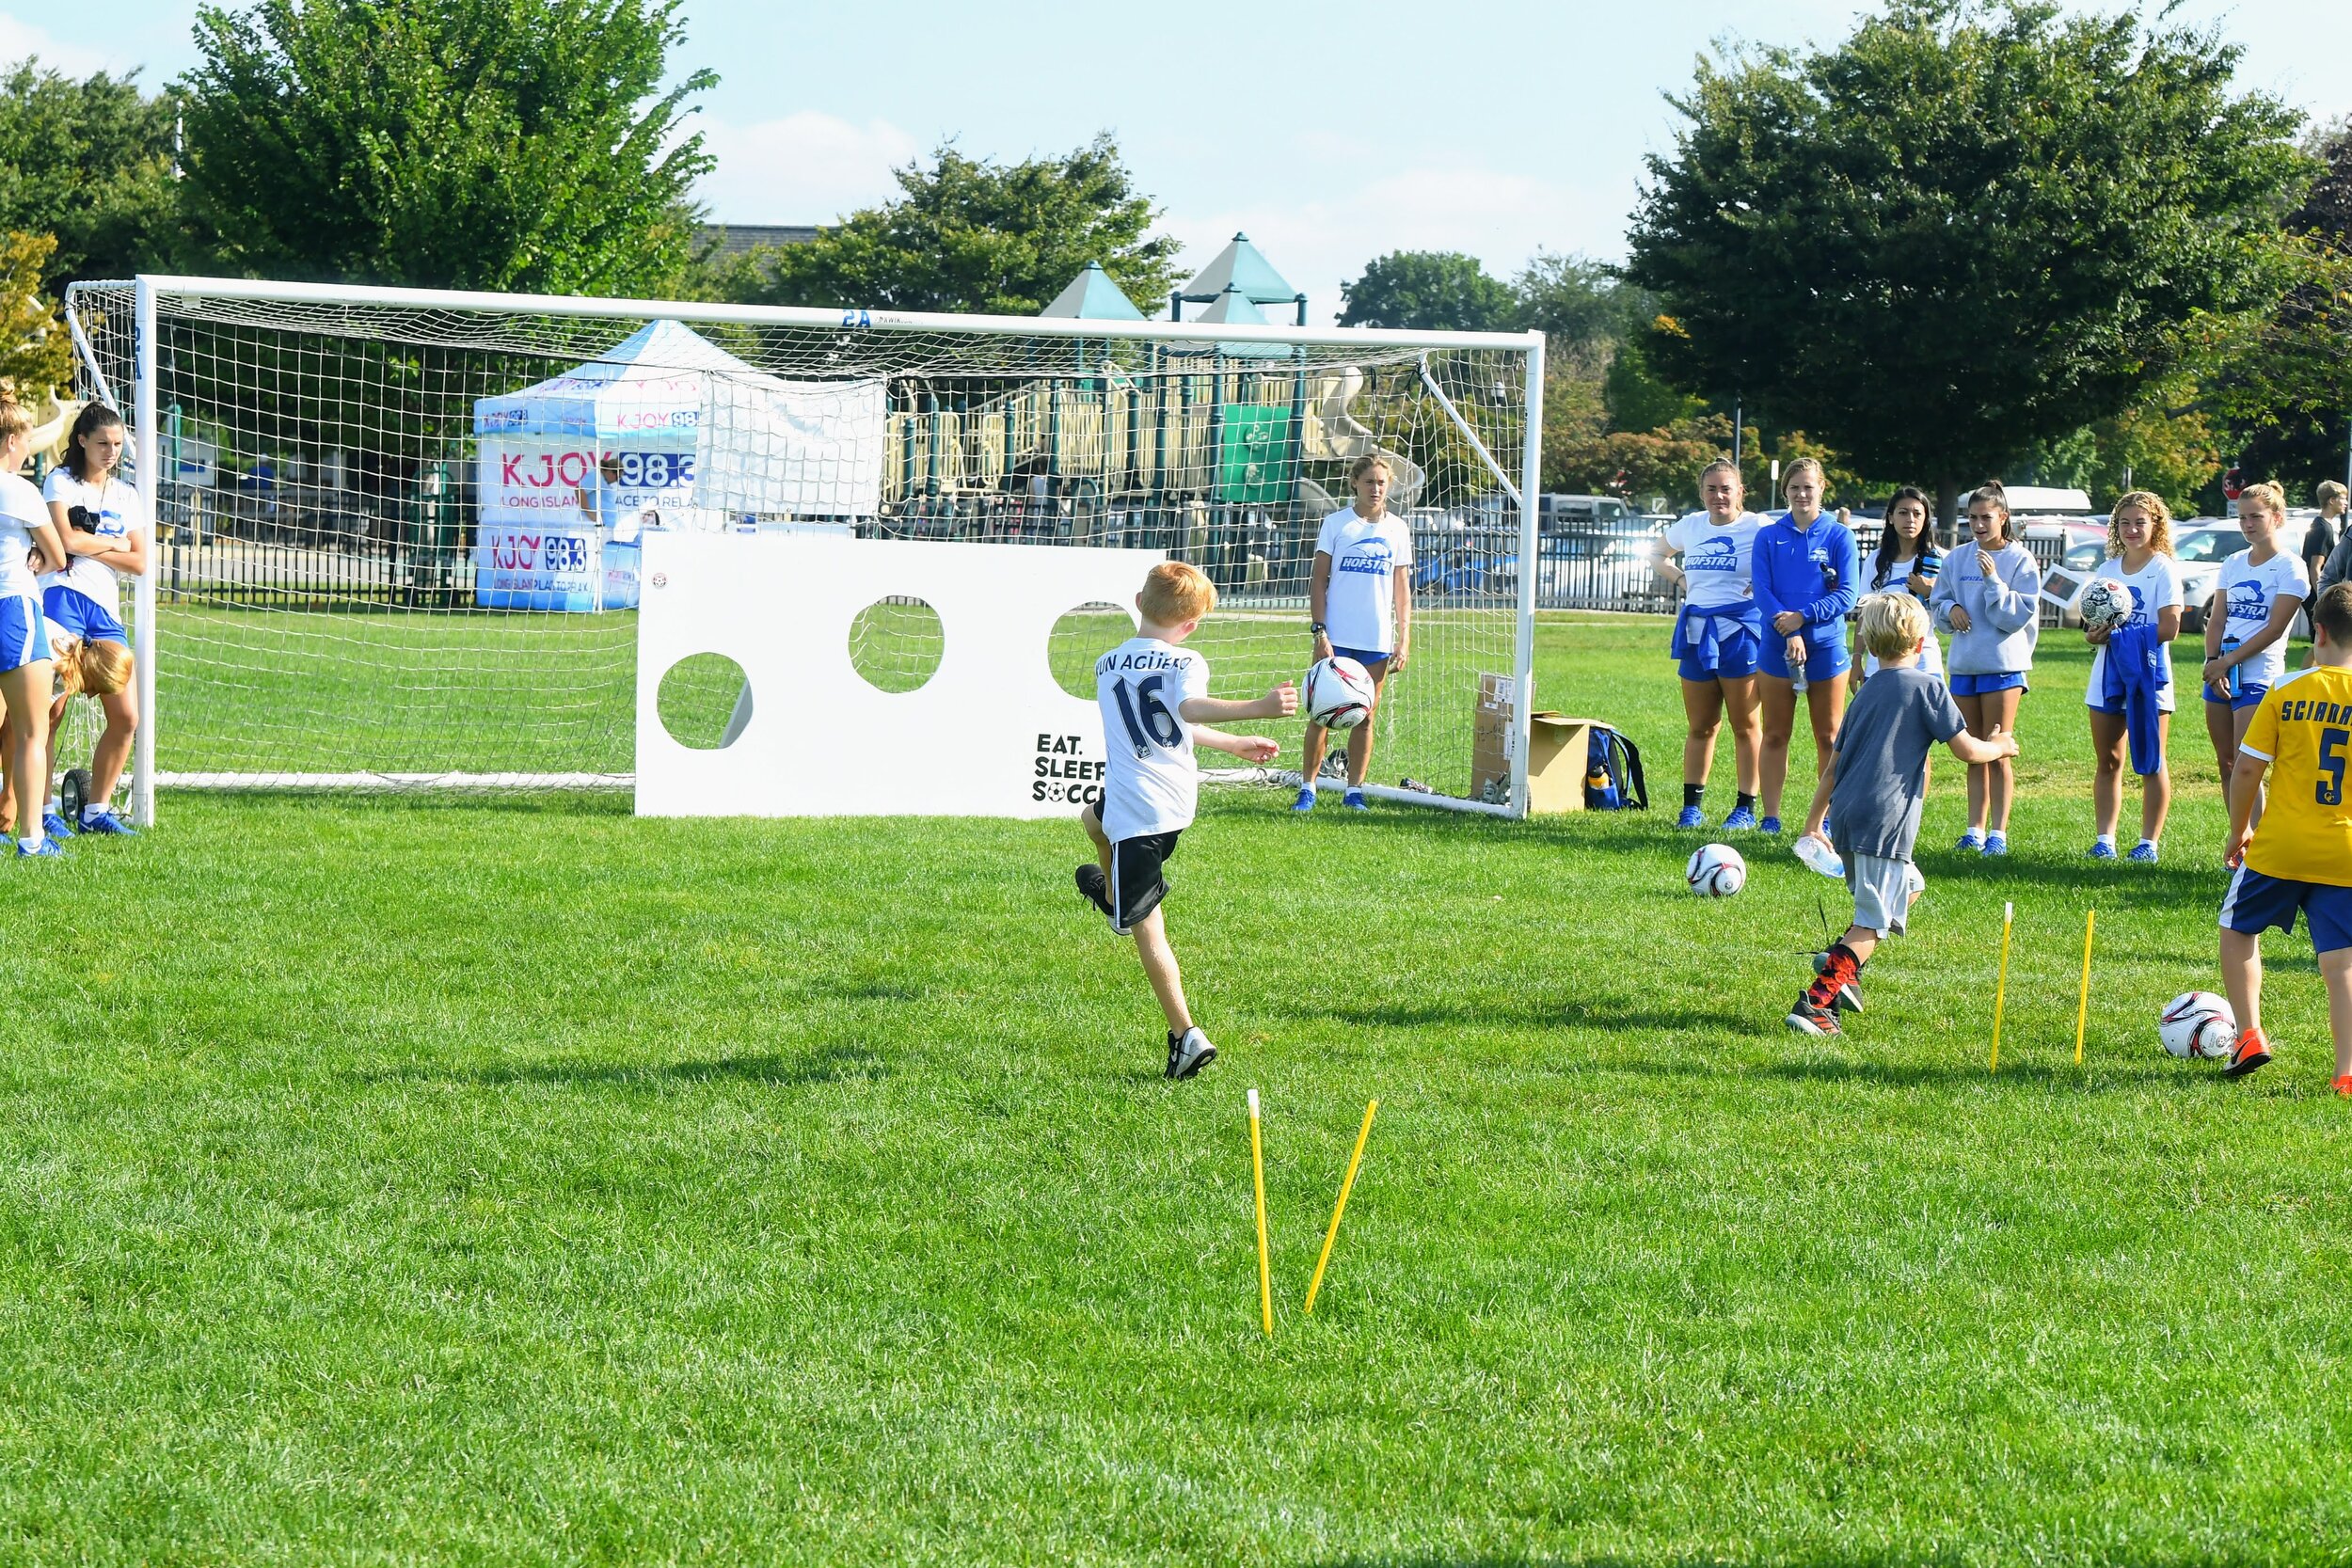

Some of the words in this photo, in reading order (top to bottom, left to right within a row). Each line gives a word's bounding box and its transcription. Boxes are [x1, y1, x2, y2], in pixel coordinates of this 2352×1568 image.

[672, 411, 699, 427] 98
[620, 452, 696, 488] 98.3
[542, 495, 580, 508] ISLAN
[614, 495, 640, 507] ACE
[662, 496, 696, 508] RELA
[1686, 556, 1736, 566] HOFSTRA
[1110, 673, 1185, 761] 16
[2280, 700, 2352, 726] SCIANA
[1037, 734, 1083, 755] EAT.
[2314, 727, 2351, 806] 5
[1031, 780, 1105, 805] SOCC
